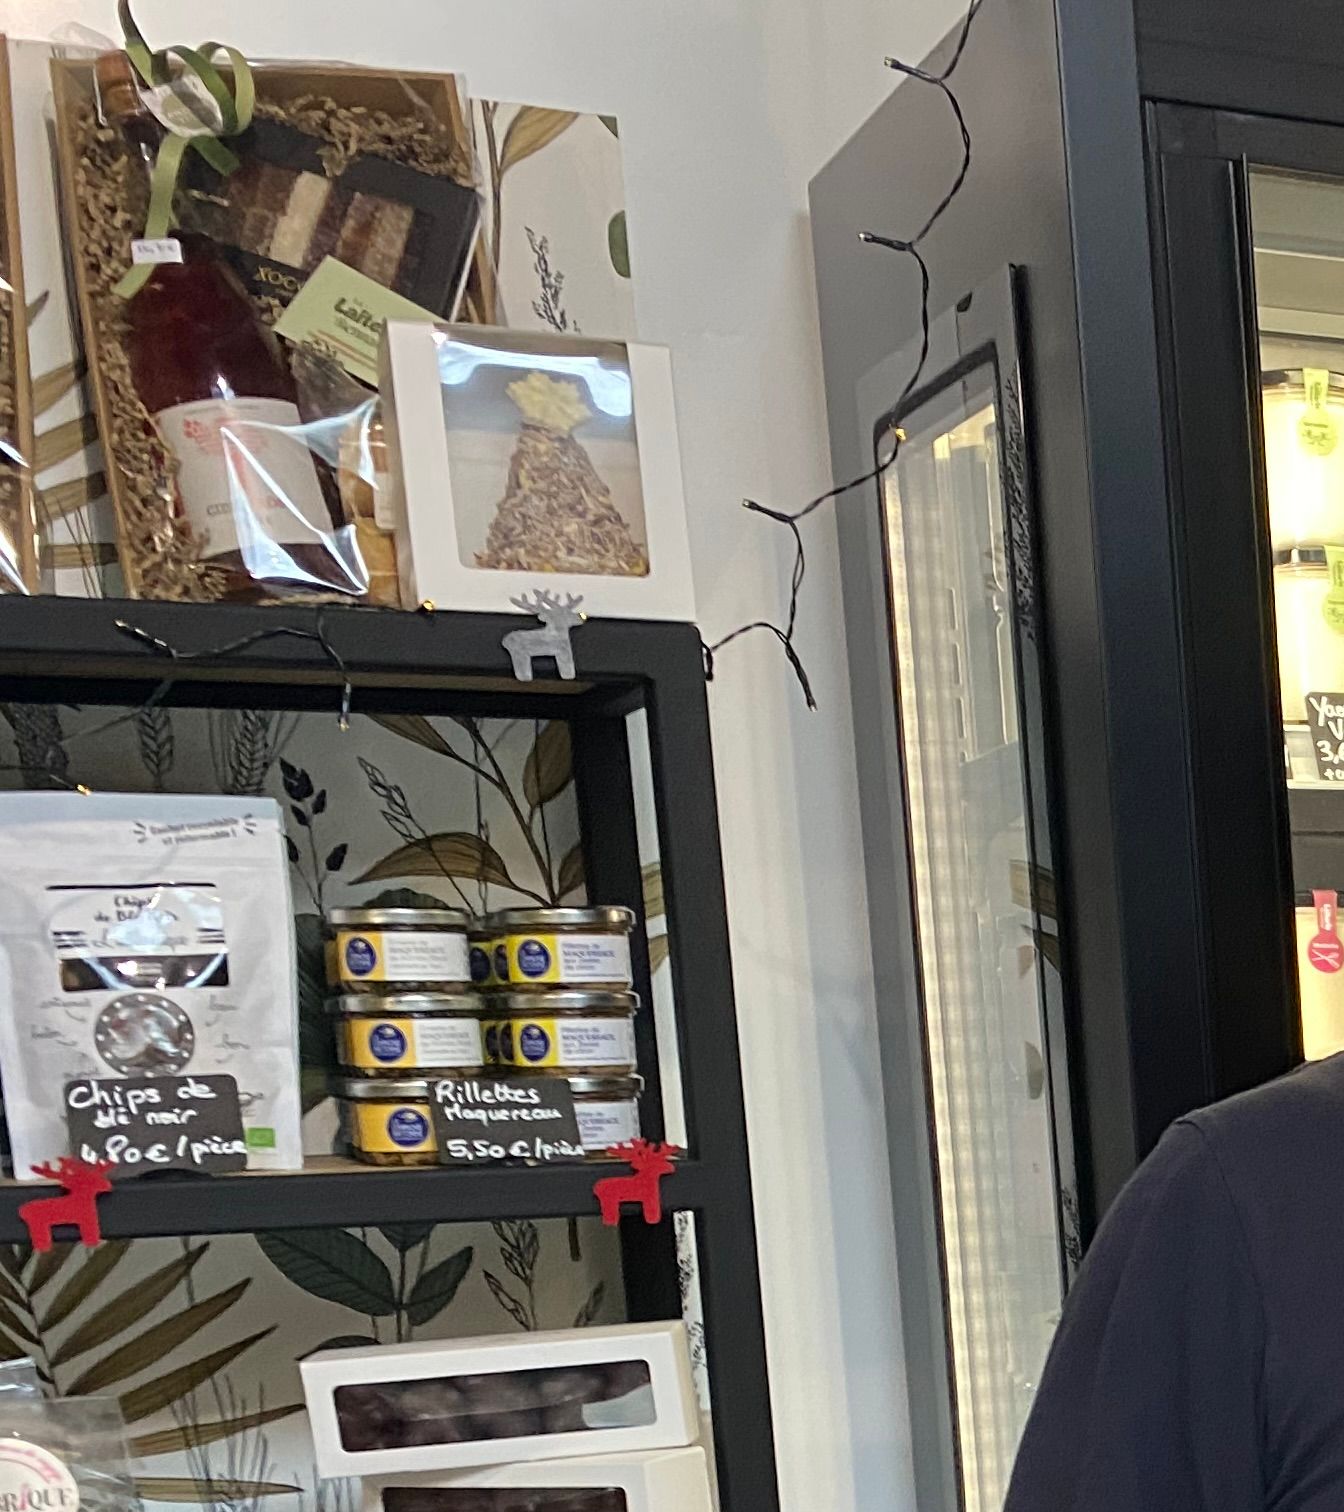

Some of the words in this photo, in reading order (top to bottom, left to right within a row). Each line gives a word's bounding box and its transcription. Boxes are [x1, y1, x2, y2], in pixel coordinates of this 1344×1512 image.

[68, 1079, 162, 1115] Chips
[177, 1078, 218, 1099] de
[434, 1080, 542, 1105] Rillettes
[144, 1108, 198, 1126] noir
[443, 1103, 563, 1127] Maquereau
